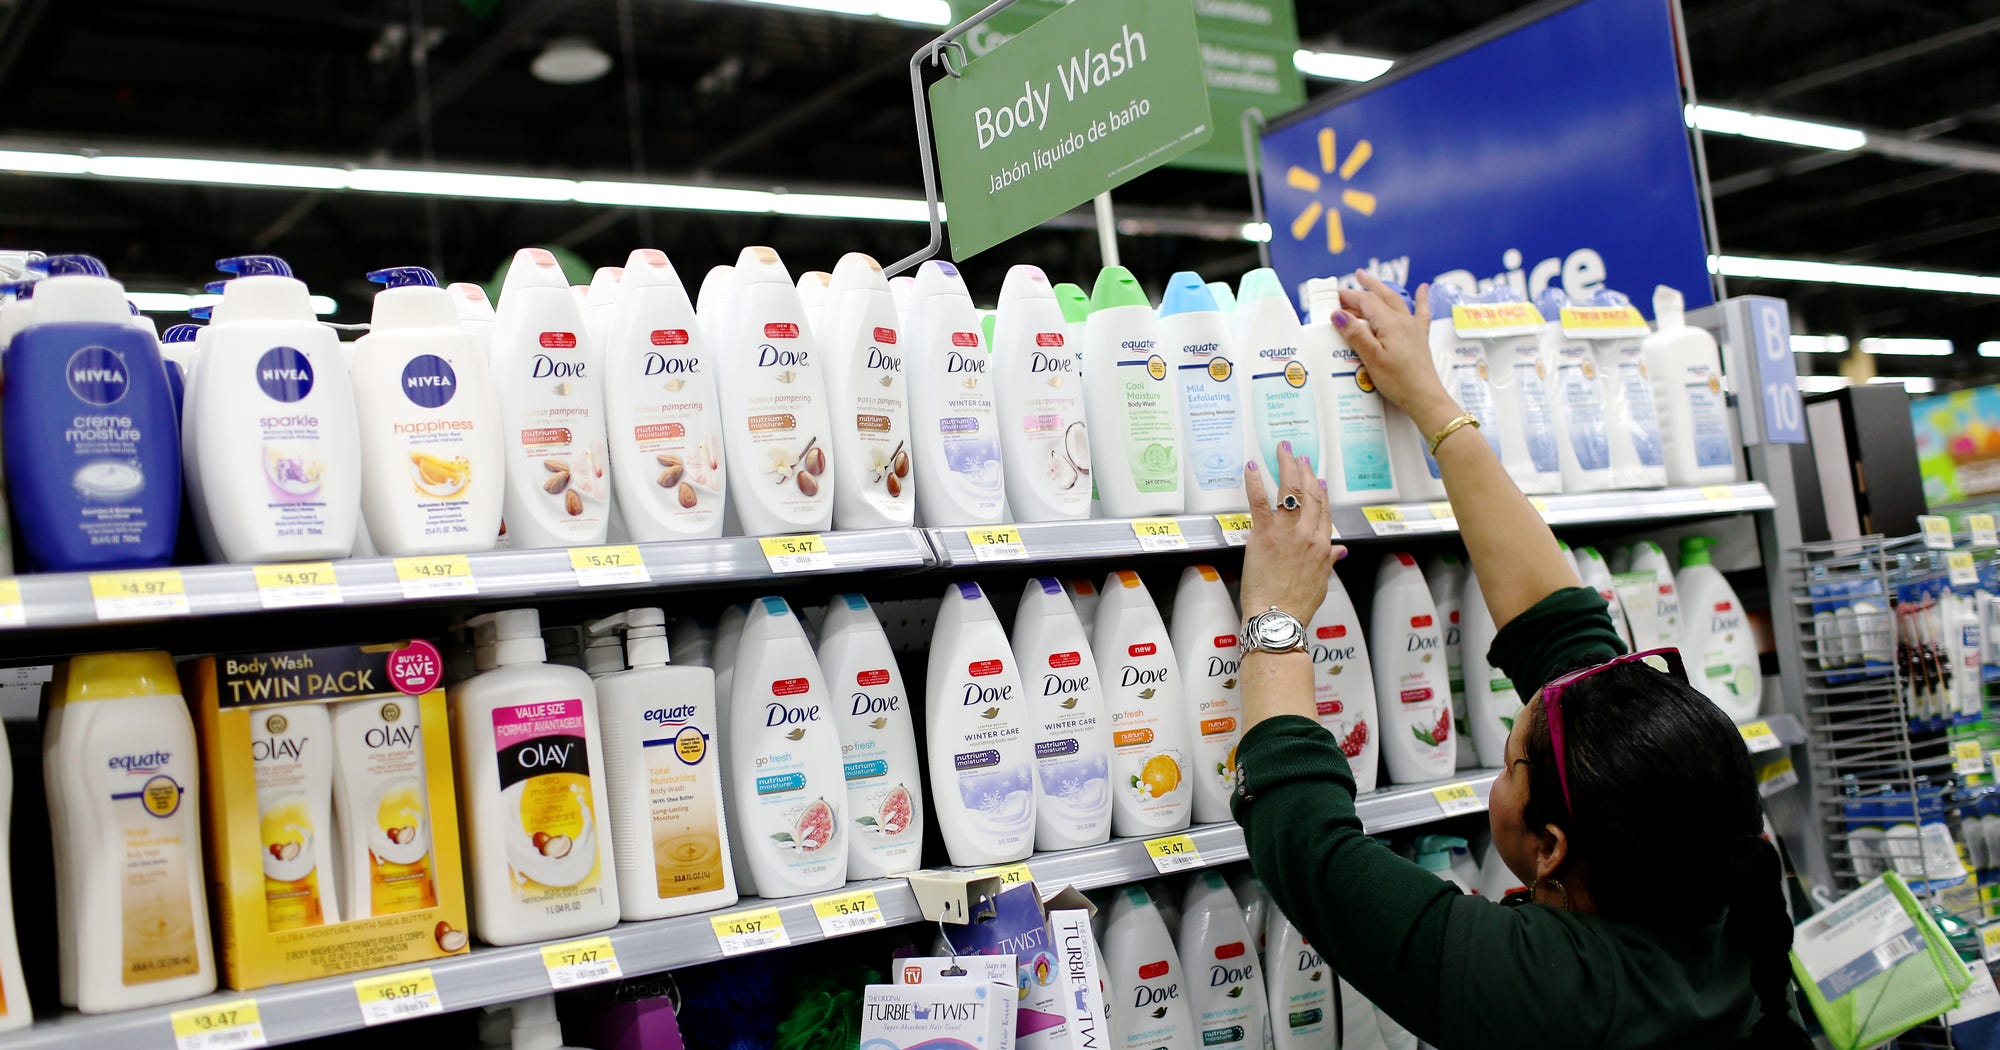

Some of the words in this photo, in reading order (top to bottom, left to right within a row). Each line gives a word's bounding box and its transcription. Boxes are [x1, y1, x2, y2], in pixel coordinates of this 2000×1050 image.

[974, 80, 1051, 150] Body
[1056, 24, 1147, 102] Wash
[989, 161, 1031, 194] Jabón
[1032, 132, 1084, 171] líquido
[1087, 120, 1107, 142] de
[1109, 98, 1150, 132] baño
[1761, 307, 1785, 358] B
[1121, 339, 1157, 352] equate
[1183, 342, 1220, 354] equate
[1259, 346, 1298, 359] equate
[758, 343, 810, 367] Dove
[867, 346, 902, 372] Dove
[1031, 351, 1072, 373] Dove
[532, 353, 588, 378] Dove
[644, 351, 701, 376] Dove
[947, 351, 986, 374] Dove
[74, 369, 124, 383] NIVEA
[262, 369, 309, 381] NIVEA
[407, 376, 452, 388] NIVEA
[1125, 382, 1145, 390] Cool
[1186, 384, 1204, 393] Mild
[774, 394, 811, 405] pampering
[1126, 392, 1161, 400] Moisture
[1188, 393, 1231, 402] Exfoliating
[1265, 391, 1299, 401] Sensitive
[661, 401, 703, 413] pampering
[948, 399, 977, 408] WINTER
[978, 400, 992, 408] CARE
[1127, 401, 1142, 409] Body
[1767, 382, 1799, 430] 10
[549, 407, 589, 418] pampering
[73, 416, 132, 428] creme
[259, 414, 319, 429] sparkle
[393, 418, 474, 435] happiness
[636, 424, 670, 433] nutrium
[941, 418, 969, 426] nutrium
[65, 428, 141, 442] moisture
[524, 428, 558, 437] nutrium
[1145, 525, 1170, 537] $3.47
[1230, 520, 1253, 531] $3.47
[982, 533, 1010, 545] $5.47
[782, 541, 813, 554] $5.47
[586, 554, 621, 567] $5.47
[415, 563, 454, 578] $4.97
[277, 571, 319, 587] $4.97
[121, 580, 166, 596] $4.97
[1407, 633, 1440, 652] Dove
[1134, 646, 1151, 654] new
[1313, 644, 1355, 664] Dove
[226, 657, 268, 676] Body
[270, 652, 314, 670] Wash
[398, 655, 416, 663] BUY
[416, 654, 423, 662] 2
[395, 661, 435, 678] SAVE
[1207, 656, 1241, 677] Dov
[1121, 665, 1168, 687] Dove
[227, 675, 301, 702] TWIN
[307, 669, 375, 695] PACK
[1043, 673, 1089, 697] Dove
[963, 682, 1012, 706] Dove
[515, 704, 546, 719] VALUE
[546, 702, 566, 716] SIZE
[851, 692, 900, 716] Dove
[1200, 702, 1210, 711] go
[1210, 699, 1228, 707] fresh
[643, 704, 696, 723] equate
[766, 702, 821, 727] Dove
[1112, 712, 1123, 722] go
[1124, 709, 1144, 718] fresh
[498, 721, 533, 737] FORMAT
[1045, 720, 1076, 731] WINTER
[1078, 717, 1097, 726] CARE
[365, 725, 420, 749] OLAY
[965, 730, 998, 742] WINTER
[1000, 728, 1020, 737] CARE
[1121, 731, 1145, 739] nutrium
[252, 737, 309, 761] OLAY
[841, 744, 854, 754] go
[854, 740, 876, 750] fresh
[1037, 740, 1067, 750] nutrium
[109, 750, 174, 772] equate
[518, 742, 571, 768] OLAY
[756, 757, 768, 767] go
[769, 753, 792, 764] fresh
[956, 752, 987, 761] nutrium
[957, 758, 989, 766] moisture
[649, 767, 671, 776] Total
[845, 761, 876, 771] nutrium
[846, 768, 877, 776] moisture
[650, 773, 697, 785] Moisturizing
[758, 775, 792, 785] nutrium
[530, 784, 570, 797] moisture
[651, 787, 666, 796] Body
[759, 782, 793, 791] moisture
[652, 805, 689, 816] Long-Lasting
[530, 812, 575, 826] hydratant
[1159, 842, 1184, 855] $5.47
[674, 875, 686, 883] 33.8
[692, 872, 701, 880] OZ
[834, 900, 865, 915] $5.47
[277, 934, 304, 945] ULTRA
[307, 925, 350, 941] MOISTURE
[353, 921, 375, 933] WITH
[376, 918, 400, 930] SHEA
[401, 912, 433, 926] BUTTER
[728, 919, 762, 935] $4.97
[379, 935, 395, 945] POUR
[396, 934, 404, 943] LE
[405, 930, 426, 942] CORPS
[997, 926, 1044, 956] TWIST
[562, 950, 598, 968] $7.47
[1063, 920, 1088, 985] TURBIE
[984, 962, 999, 970] Stays
[1298, 950, 1322, 971] Do
[905, 971, 921, 983] TV
[987, 971, 1005, 979] Place!
[1210, 965, 1254, 987] Dove
[379, 983, 419, 999] $6.97
[1134, 984, 1179, 1008] Dove
[867, 1003, 912, 1021] TURBIE
[931, 1002, 981, 1021] TWIST
[194, 1010, 239, 1029] $3.47
[929, 1023, 943, 1031] Hair
[943, 1023, 962, 1031] Towel
[1204, 1029, 1232, 1038] nutrium
